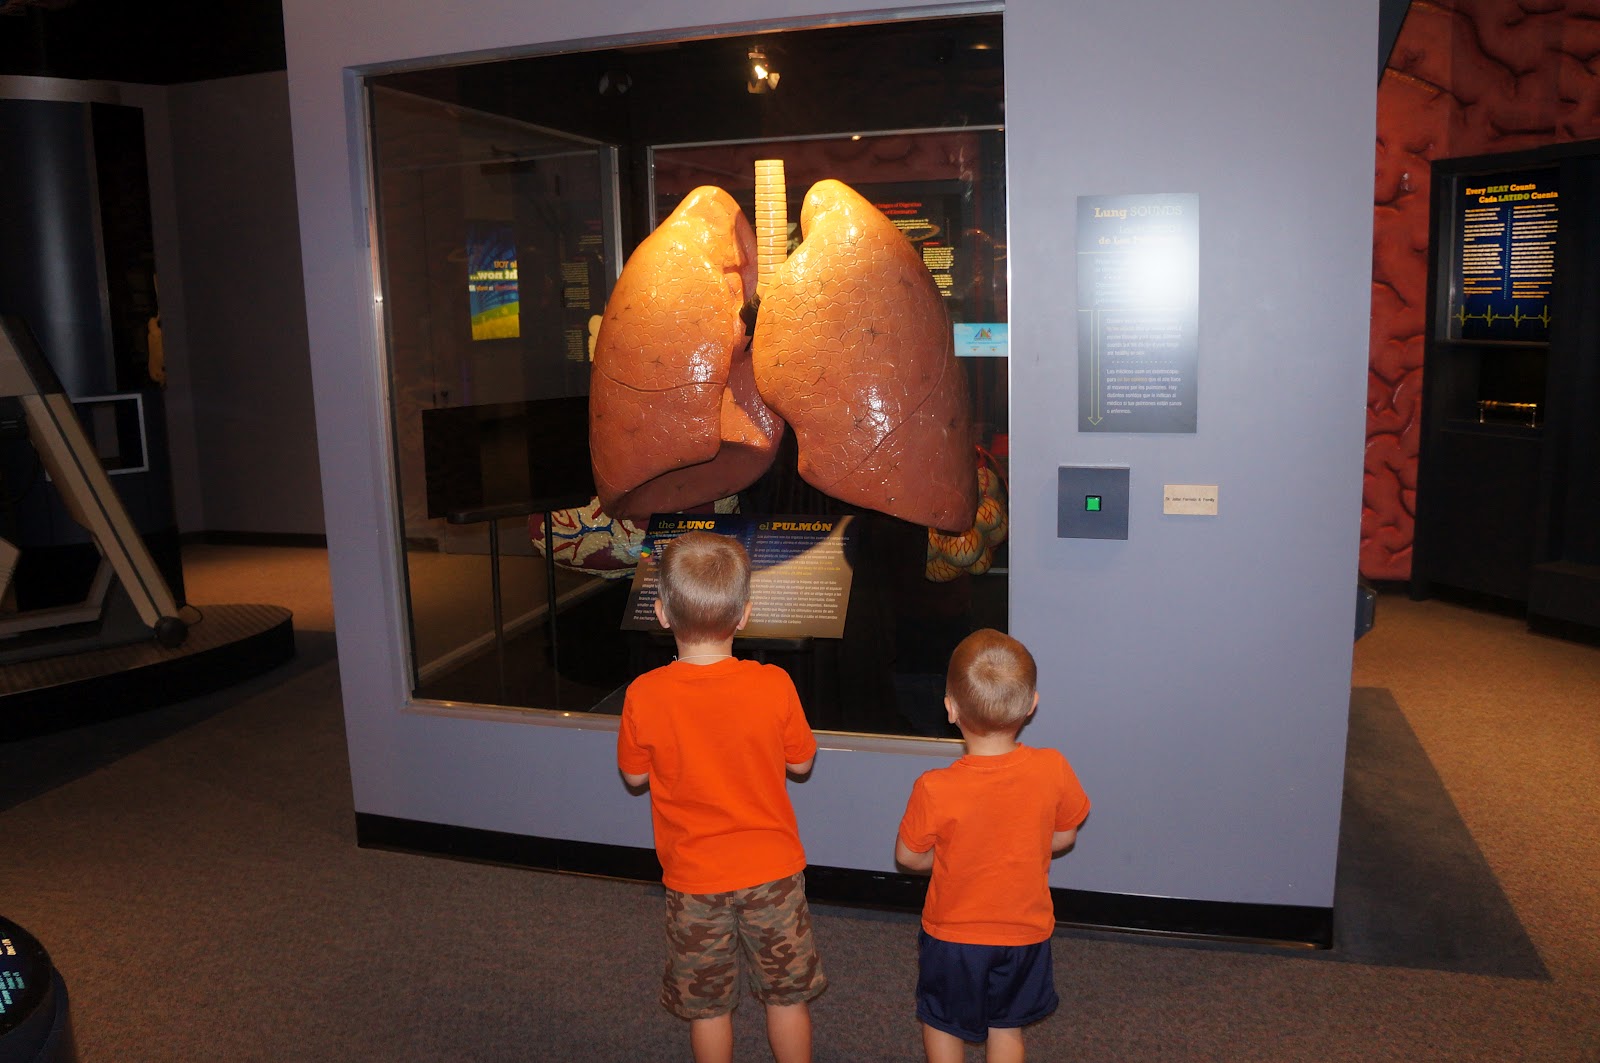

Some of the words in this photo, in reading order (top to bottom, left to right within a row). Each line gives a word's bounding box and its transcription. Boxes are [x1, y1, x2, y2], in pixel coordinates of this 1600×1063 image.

[1465, 188, 1486, 196] Every
[1487, 185, 1509, 193] BEAT
[1509, 183, 1536, 191] Counts
[1498, 193, 1530, 202] LATIDO
[1531, 191, 1558, 199] Cuenta
[1094, 207, 1127, 220] Lung
[1130, 205, 1183, 217] SOUNDS
[658, 520, 675, 529] the
[677, 520, 715, 530] LUNG
[759, 521, 769, 531] el
[771, 520, 833, 532] PULMÓN
